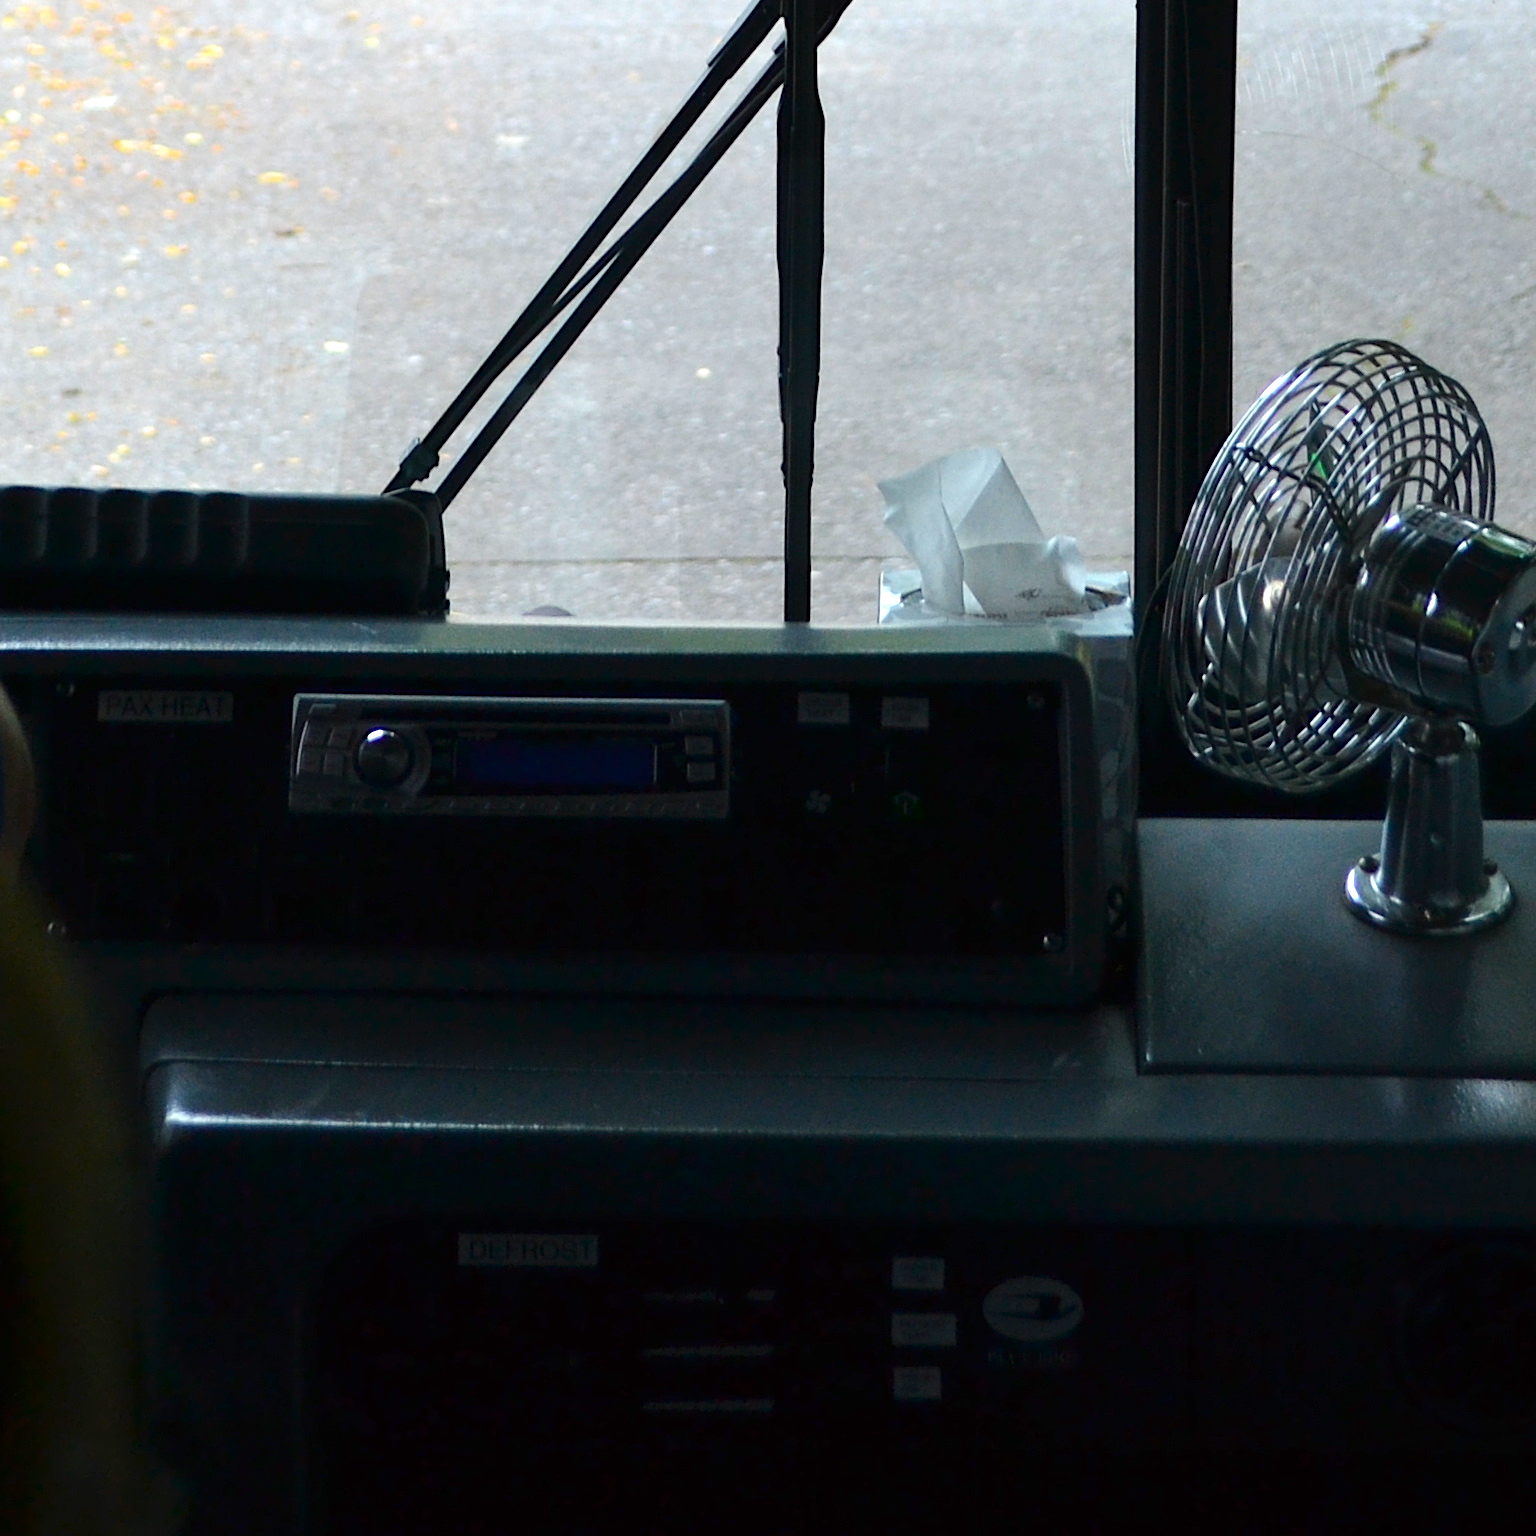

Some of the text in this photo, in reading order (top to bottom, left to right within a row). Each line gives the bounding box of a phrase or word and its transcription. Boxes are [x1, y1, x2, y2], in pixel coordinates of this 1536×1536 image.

[105, 695, 226, 717] PAX HEAT
[469, 1239, 594, 1261] DEFROST
